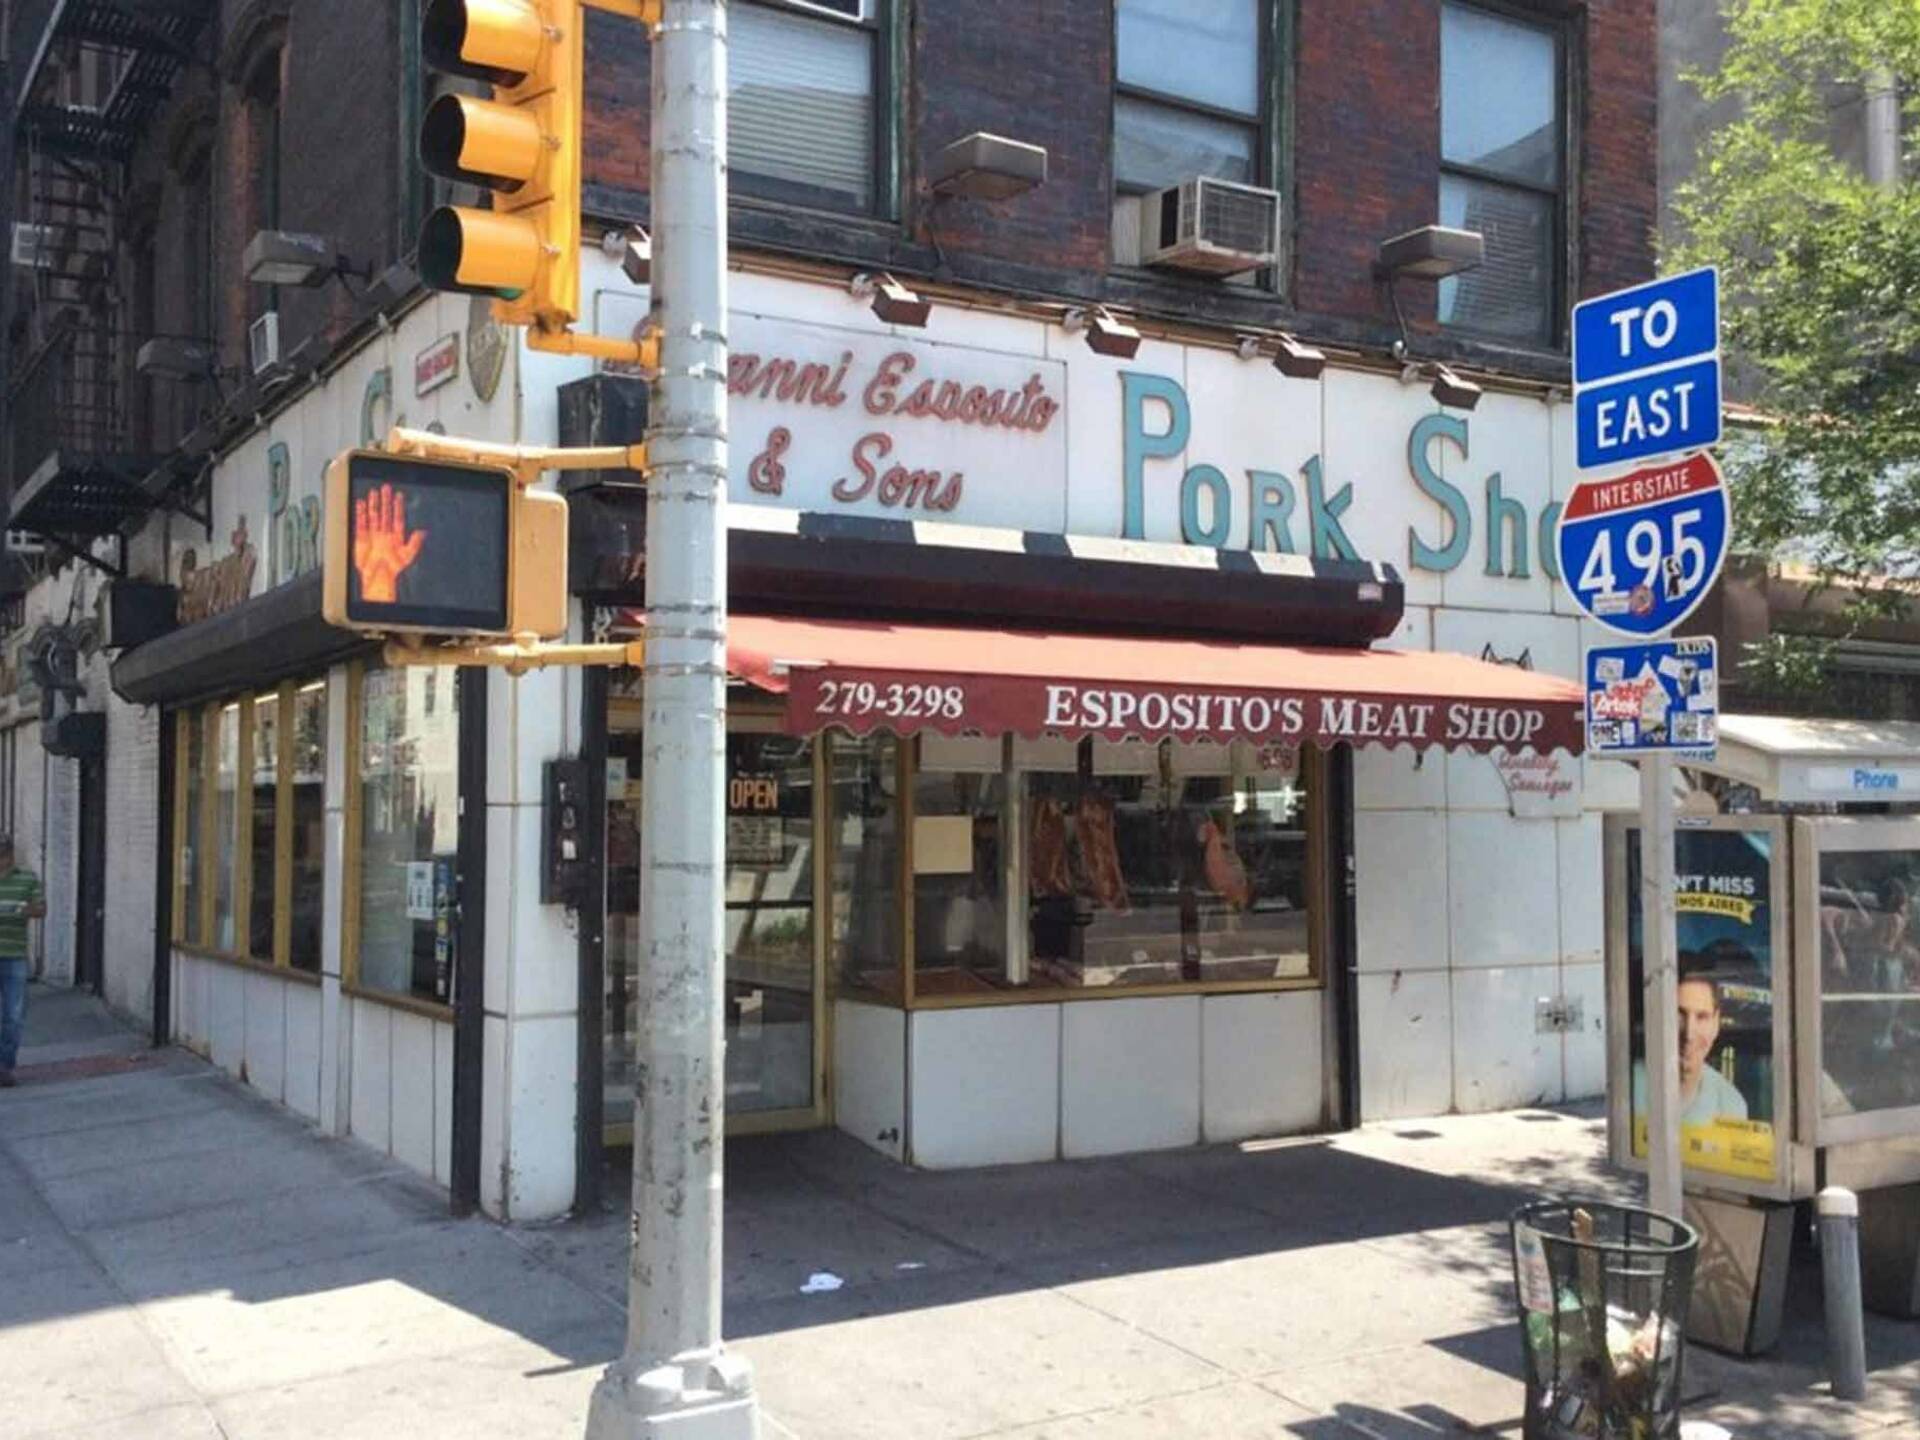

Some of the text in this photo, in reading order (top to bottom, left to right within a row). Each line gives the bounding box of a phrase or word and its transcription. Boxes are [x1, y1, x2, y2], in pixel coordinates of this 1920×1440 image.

[1610, 301, 1677, 356] TO
[863, 351, 1061, 432] Esposito
[1596, 382, 1695, 449] EAST
[748, 425, 963, 513] & Sons
[1593, 468, 1690, 510] INTERSTATE
[1577, 508, 1706, 598] 495
[815, 680, 964, 719] 279-3298
[1044, 684, 1304, 734] ESPOSITO'S
[1318, 696, 1434, 738] MEAT
[1446, 703, 1544, 743] SHOP
[730, 778, 778, 809] OPEN
[1853, 769, 1899, 791] Phone
[1674, 874, 1755, 896] N'T MISS
